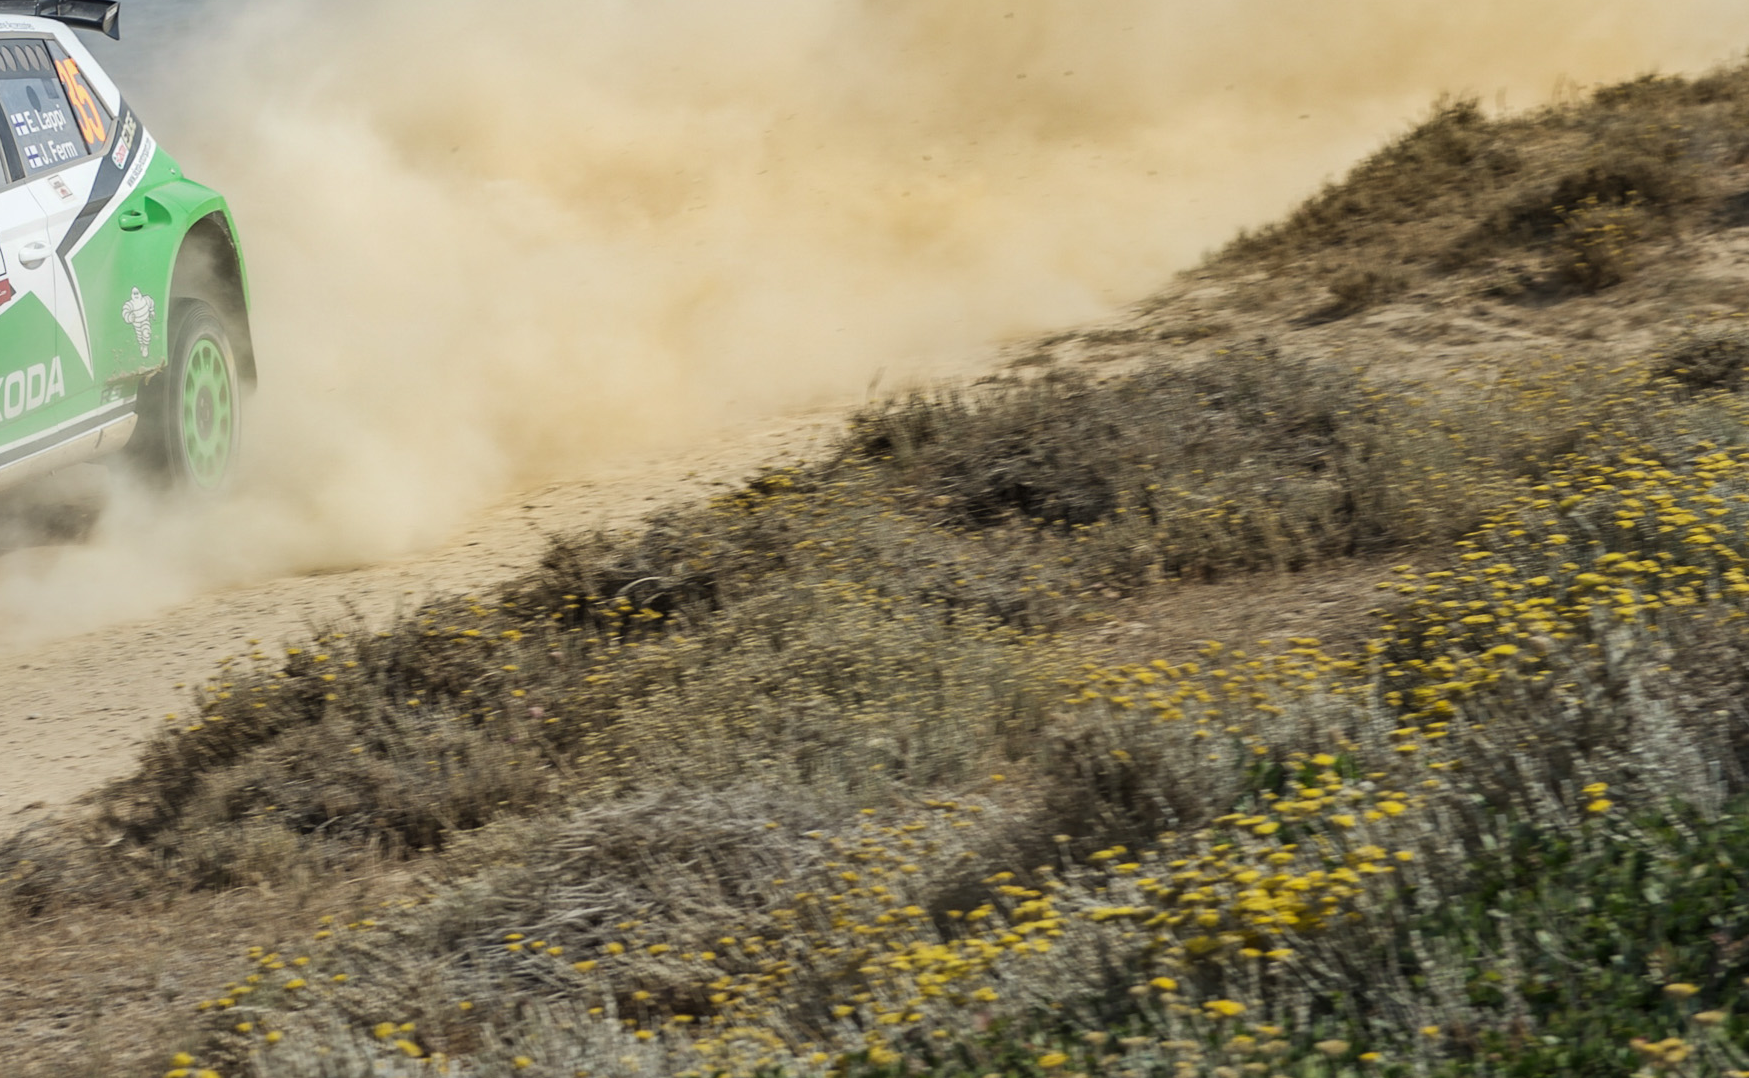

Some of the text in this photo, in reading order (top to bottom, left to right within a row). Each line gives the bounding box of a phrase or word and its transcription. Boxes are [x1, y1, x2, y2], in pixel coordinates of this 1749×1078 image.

[55, 58, 106, 144] 35
[24, 104, 67, 133] E. Lappi
[40, 140, 79, 165] J. Ferm
